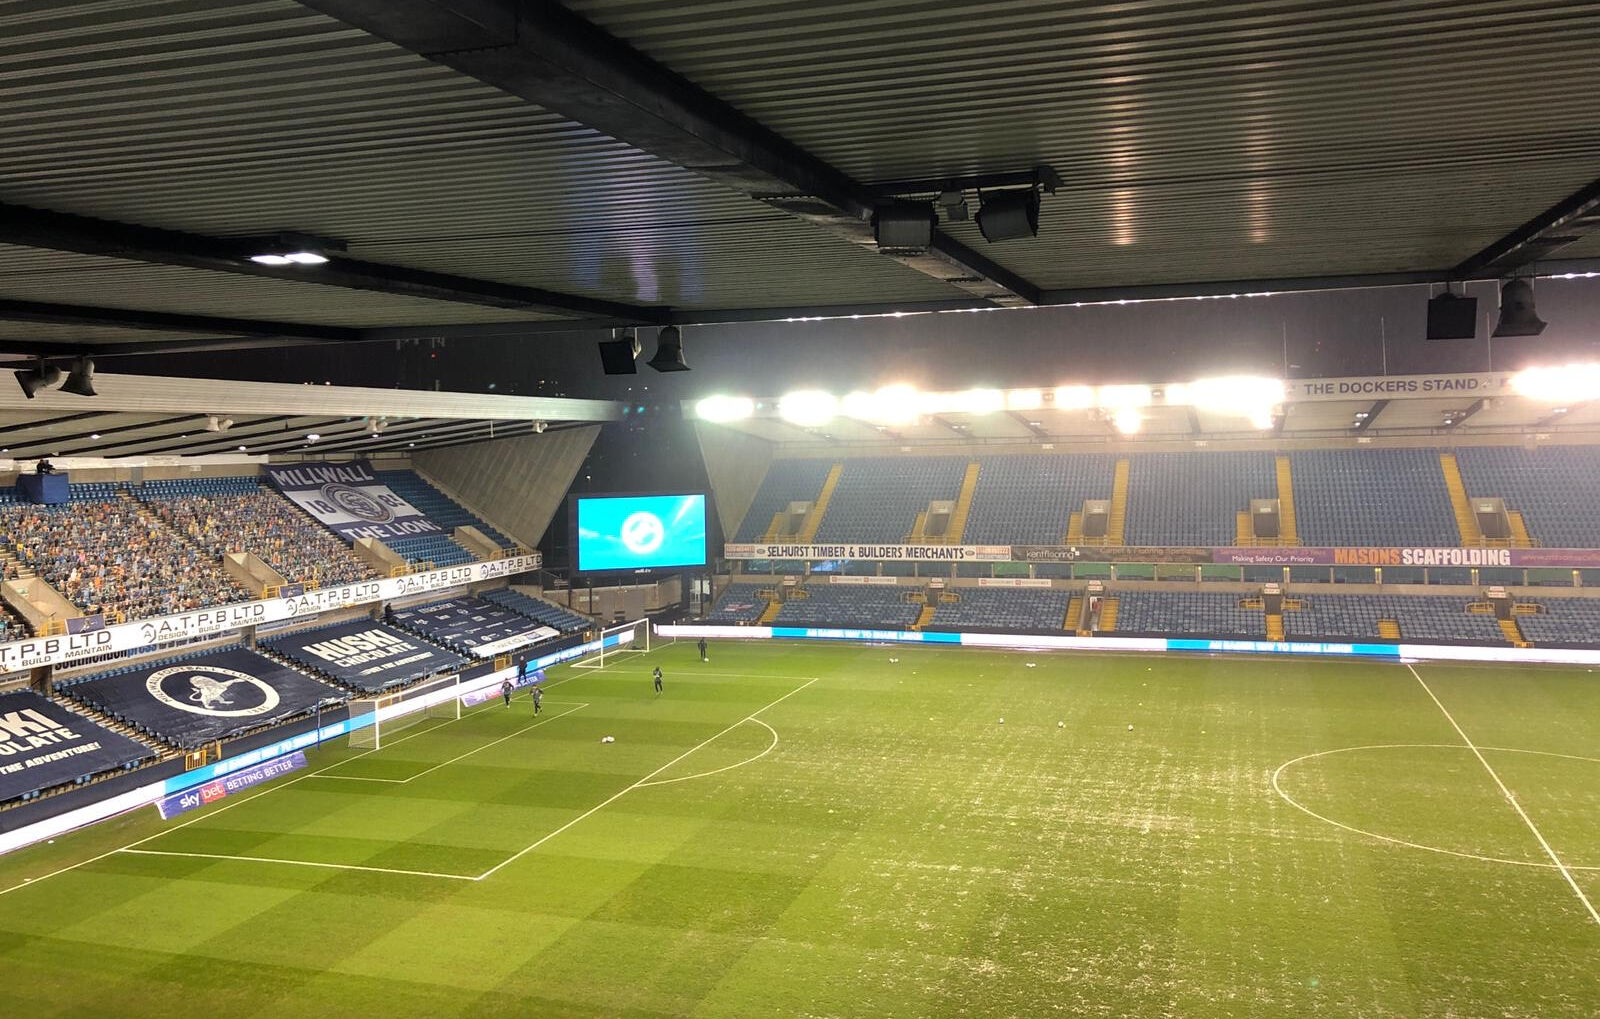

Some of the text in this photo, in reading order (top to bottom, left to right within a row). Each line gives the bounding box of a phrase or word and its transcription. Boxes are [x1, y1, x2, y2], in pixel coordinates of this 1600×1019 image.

[1304, 378, 1478, 395] THE DOCKERS STAND
[271, 465, 374, 486] MILLWALL
[305, 500, 336, 514] 18
[341, 524, 390, 539] THE
[525, 555, 542, 566] LTD
[767, 546, 810, 558] SELHURST
[812, 546, 845, 558] TIMBER
[848, 546, 855, 558] &
[858, 546, 902, 558] BUILDERS
[905, 547, 964, 559] MERCHANTS
[1232, 555, 1254, 563] Making
[1255, 555, 1274, 563] Safety
[1290, 555, 1314, 563] Priority
[1334, 548, 1400, 565] MASONS
[1402, 549, 1510, 566] SCAFFOLDING
[407, 567, 472, 587] A.T.P.B LTD
[300, 583, 380, 608] A.T.P.B LTD
[159, 610, 227, 633] A.T.P.B
[234, 604, 265, 620] LTD
[298, 605, 321, 614] DESIGN
[158, 630, 188, 641] DESIGN
[199, 624, 220, 633] BUILD
[230, 616, 265, 627] MAINTAIN
[70, 631, 111, 649] LTD
[302, 629, 403, 661] HUSKI
[22, 644, 112, 667] BUILD MAINTAIN
[333, 642, 419, 668] CHOCOLATE
[25, 741, 102, 768] ADVENTURE!
[180, 760, 293, 809] sky bet BETTING BETTER
